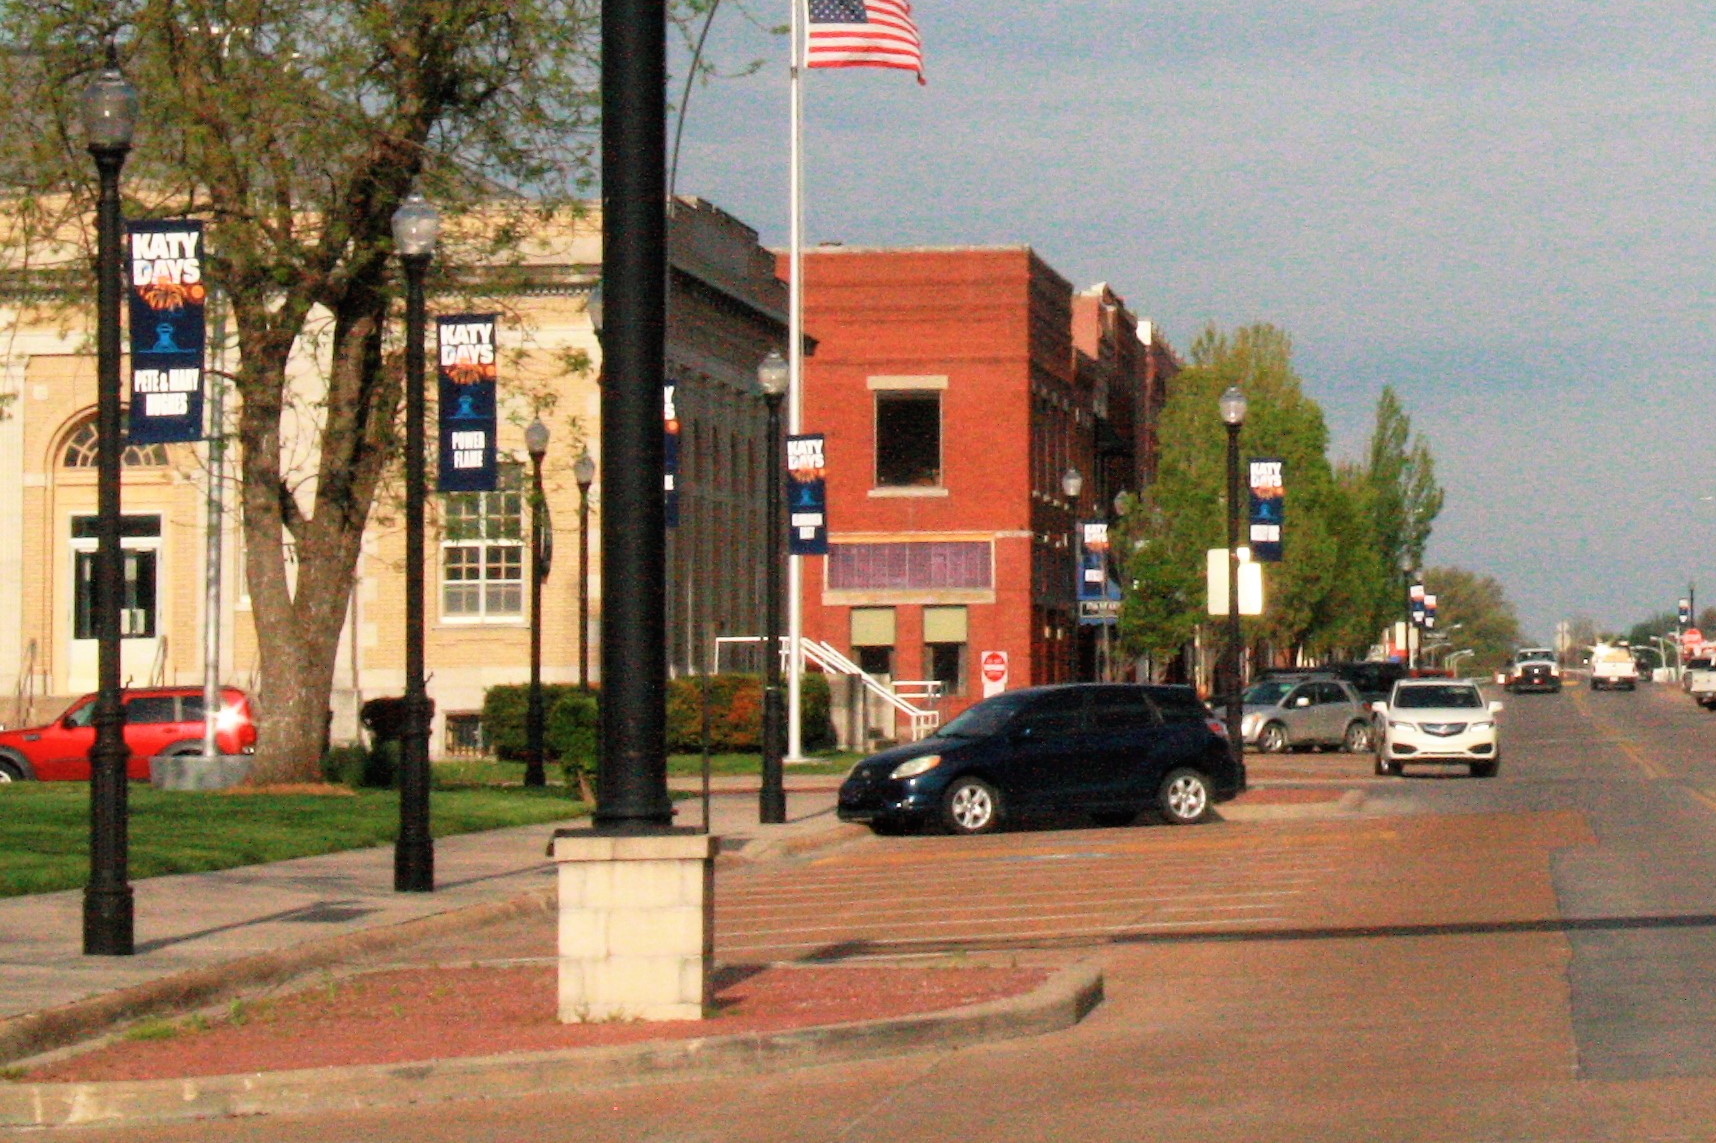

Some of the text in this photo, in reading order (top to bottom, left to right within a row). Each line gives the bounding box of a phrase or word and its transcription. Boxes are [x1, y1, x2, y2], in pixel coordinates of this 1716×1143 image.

[132, 232, 199, 259] KATY
[133, 258, 200, 286] DAYS
[440, 323, 493, 345] KATY
[441, 344, 494, 366] DAYS
[134, 369, 159, 392] PETE
[452, 431, 485, 450] POWER
[787, 439, 824, 455] KATY
